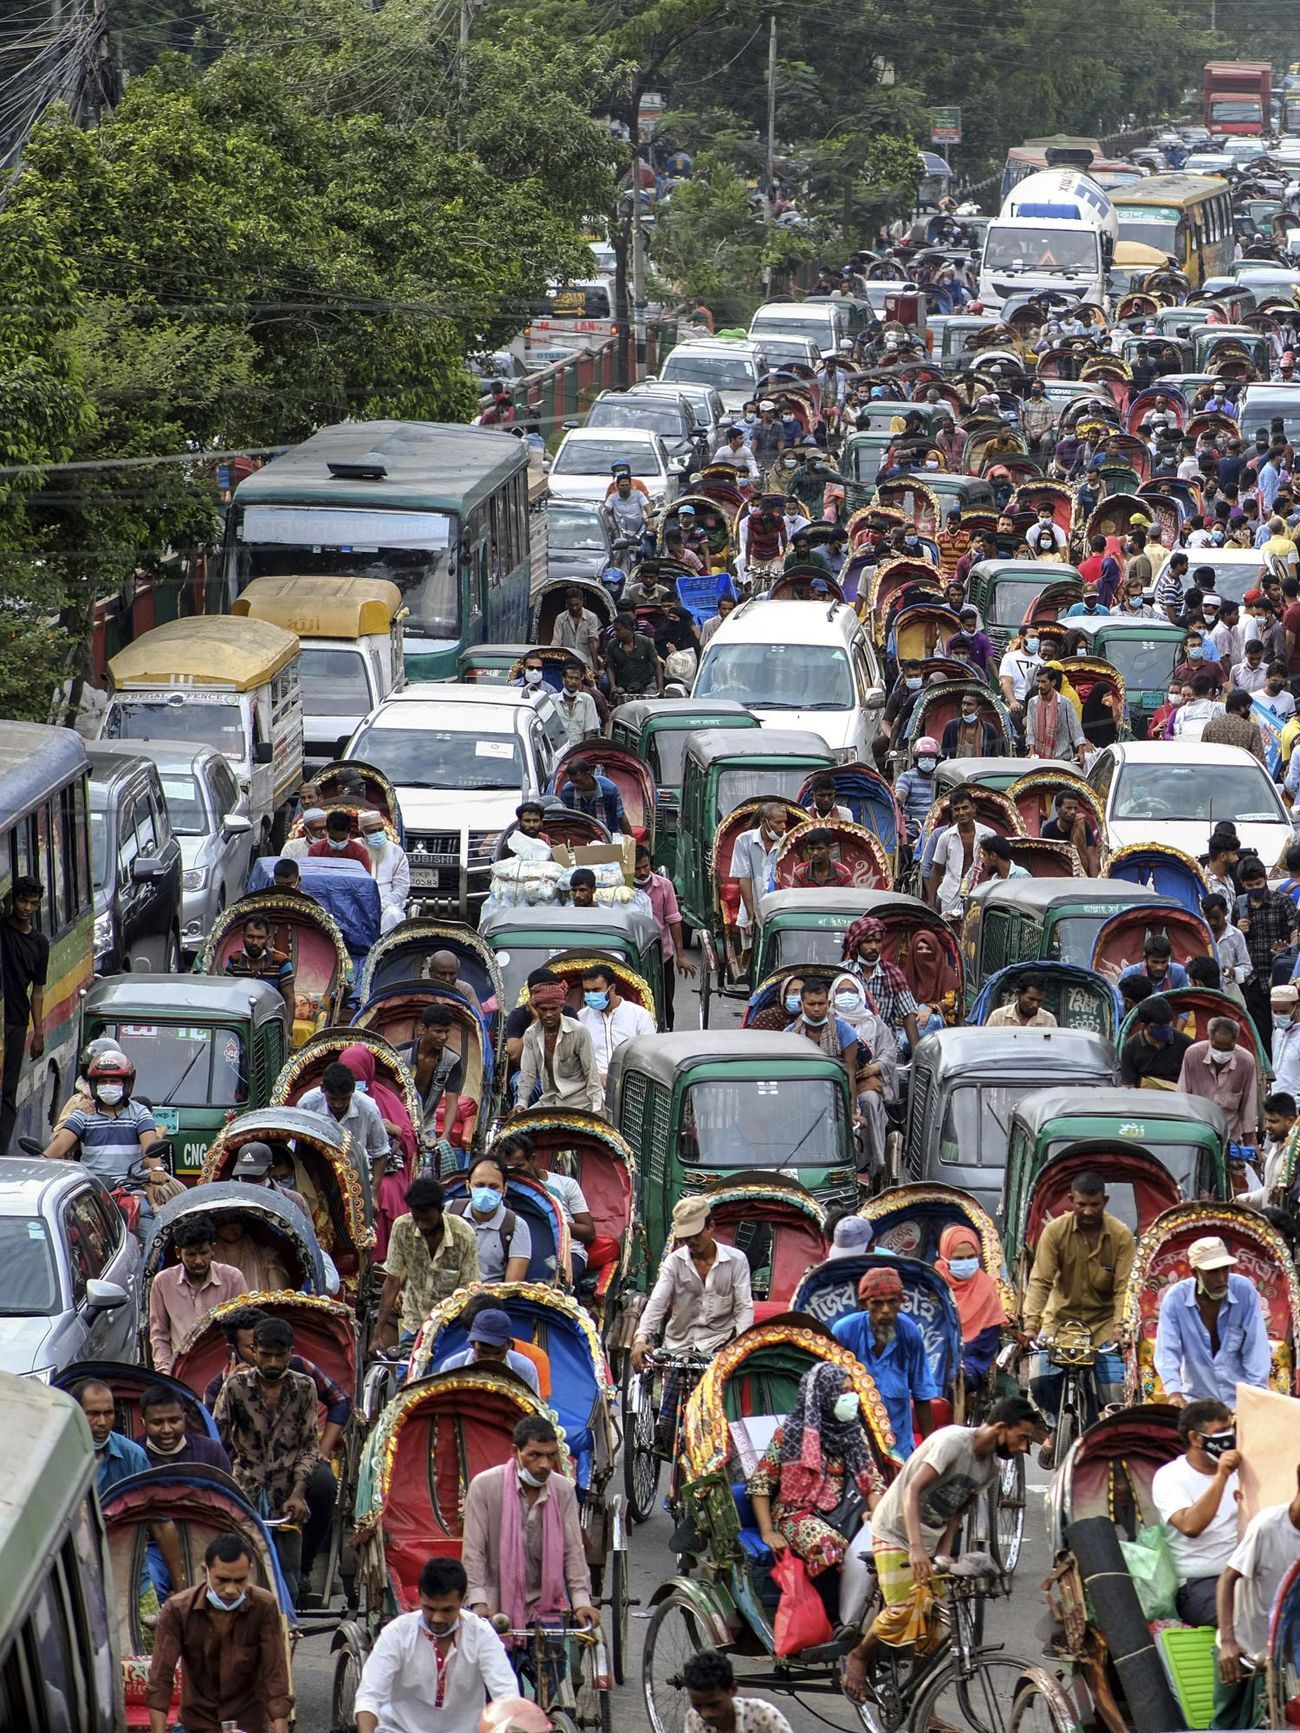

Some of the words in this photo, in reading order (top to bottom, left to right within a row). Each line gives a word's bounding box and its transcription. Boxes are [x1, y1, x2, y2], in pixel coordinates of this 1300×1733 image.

[130, 693, 168, 703] REGAL
[186, 693, 225, 703] FENCE
[407, 854, 453, 864] SUBISHI
